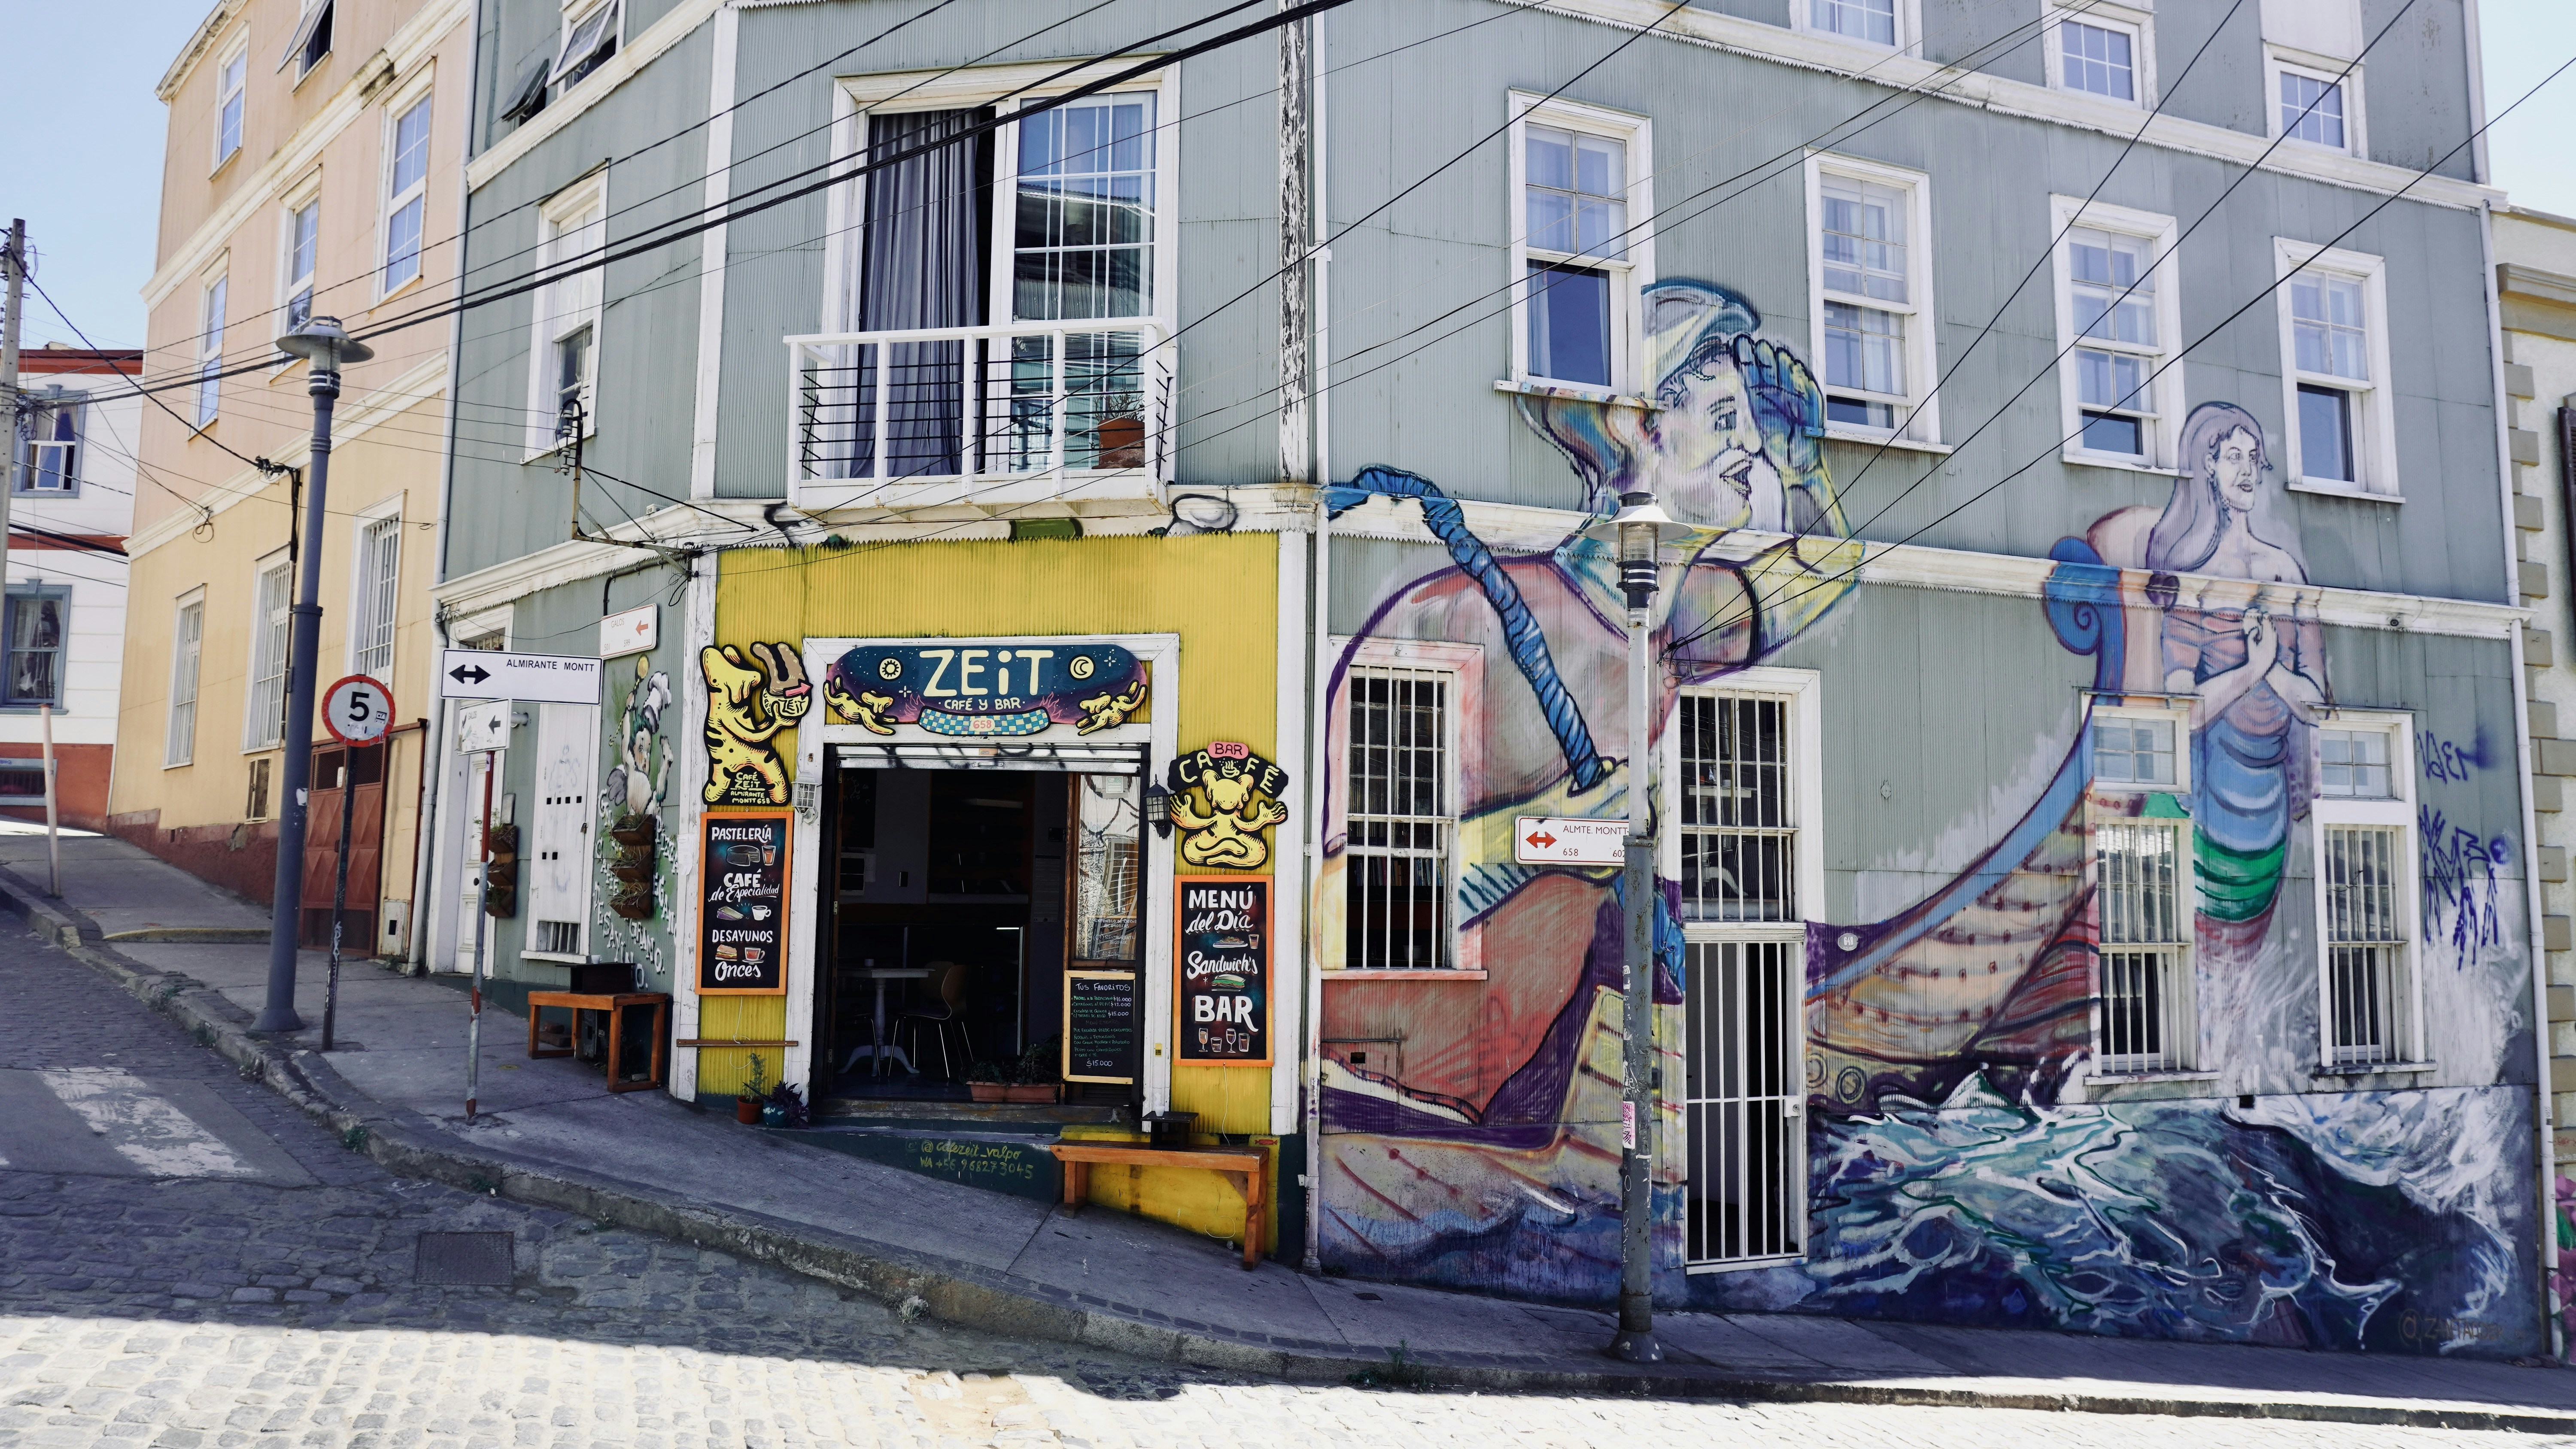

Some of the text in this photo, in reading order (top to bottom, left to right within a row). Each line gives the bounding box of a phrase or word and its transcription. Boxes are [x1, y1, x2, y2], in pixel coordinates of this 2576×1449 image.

[611, 618, 625, 628] GALOS
[506, 659, 595, 672] ALMIRANTE MONTT
[348, 691, 370, 721] 5
[944, 697, 973, 711] CAFÉ
[994, 697, 1021, 710] BAR
[973, 720, 992, 729] 658
[1215, 743, 1243, 755] BAR
[736, 771, 758, 781] CAFÉ
[711, 825, 772, 843] PASTELERÍA
[1563, 825, 1593, 834] ALMTE.
[1563, 848, 1579, 857] 658
[724, 869, 762, 888] CAFÉ
[708, 883, 780, 902] de Especialidad
[1189, 885, 1253, 909] MENÚ
[1185, 907, 1253, 933] del Día
[712, 929, 773, 943] DESAYUNOS
[1844, 937, 1853, 946] 648
[715, 961, 761, 981] Onces
[1187, 951, 1258, 979] Sandwich's
[1194, 995, 1258, 1032] BAR
[920, 1156, 933, 1168] WA
